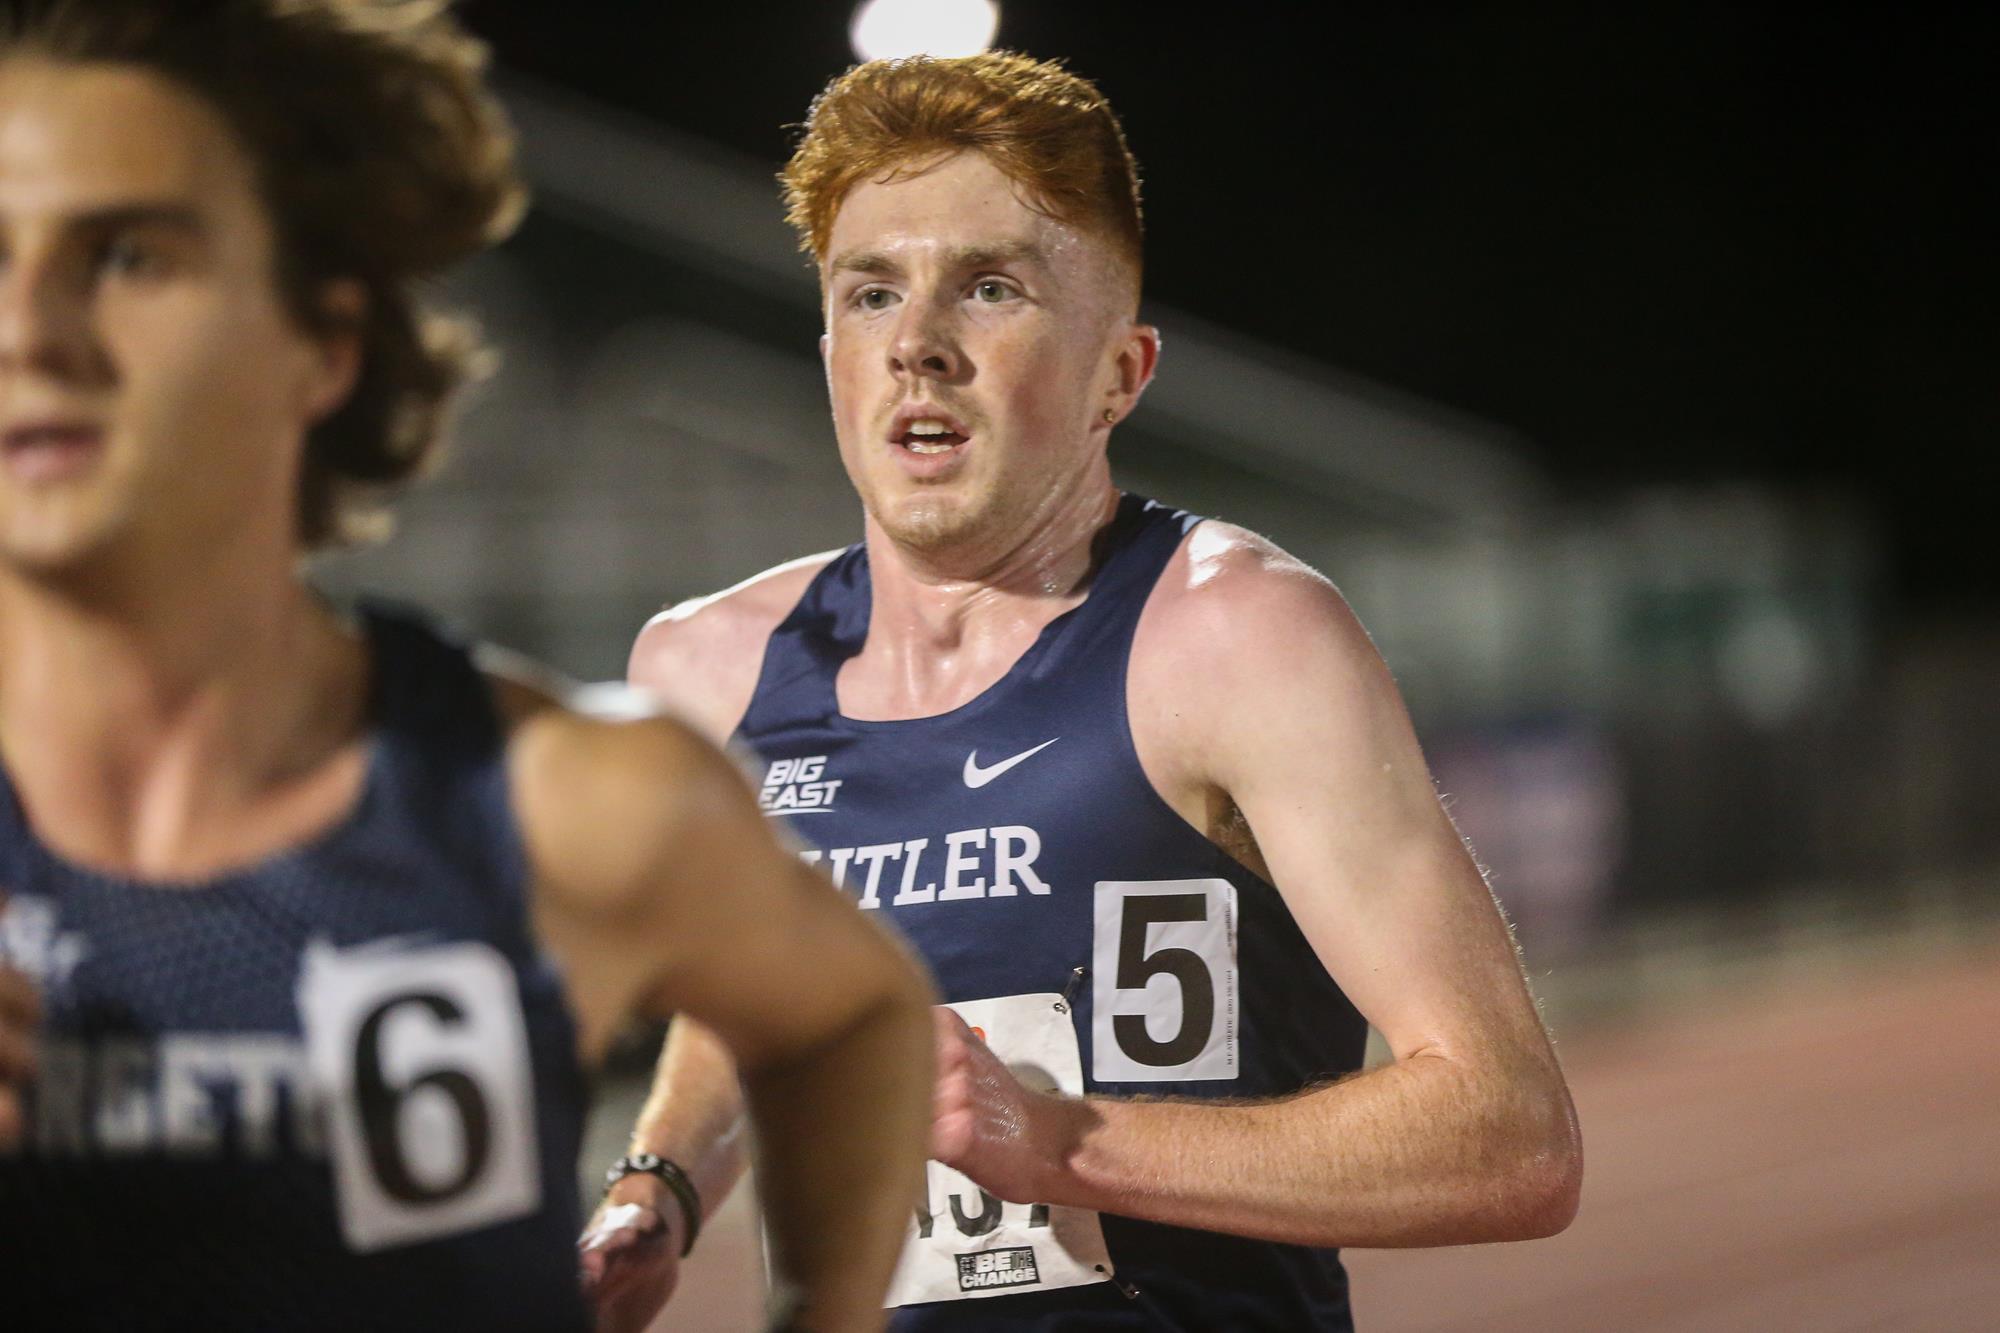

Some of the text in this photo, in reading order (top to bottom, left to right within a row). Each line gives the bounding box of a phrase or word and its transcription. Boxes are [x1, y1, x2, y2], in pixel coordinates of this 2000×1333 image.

[757, 780, 843, 809] EAST
[763, 756, 828, 787] BIG
[798, 825, 1051, 909] TLER
[1112, 893, 1214, 1067] 5
[352, 992, 491, 1210] 6
[961, 1268, 1036, 1289] CHANGE
